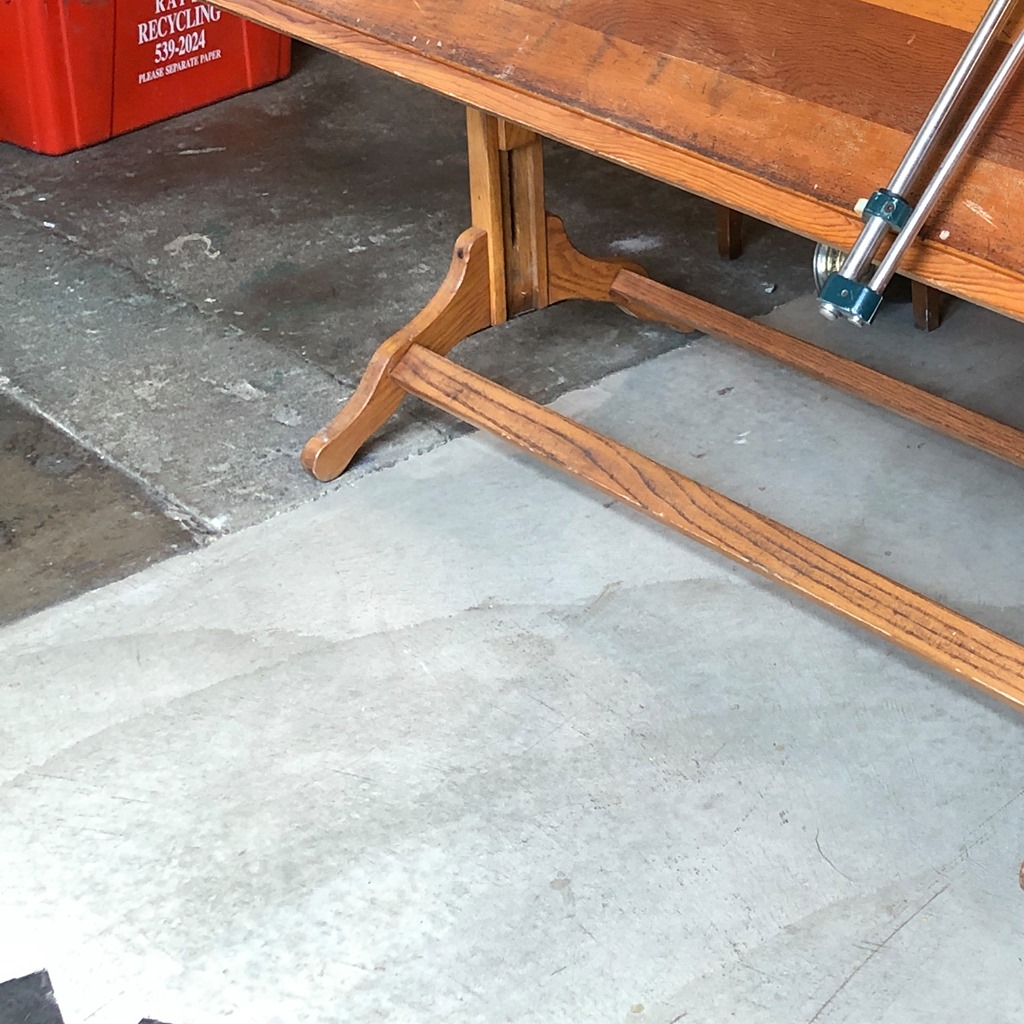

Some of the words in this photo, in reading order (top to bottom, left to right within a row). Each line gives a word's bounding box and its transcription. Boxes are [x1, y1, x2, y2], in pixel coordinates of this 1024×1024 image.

[138, 4, 222, 45] RECYCLING
[154, 29, 206, 64] 539-2024
[138, 68, 165, 84] PLEASE
[165, 56, 200, 76] SEPARATE
[200, 49, 222, 66] PAPER
